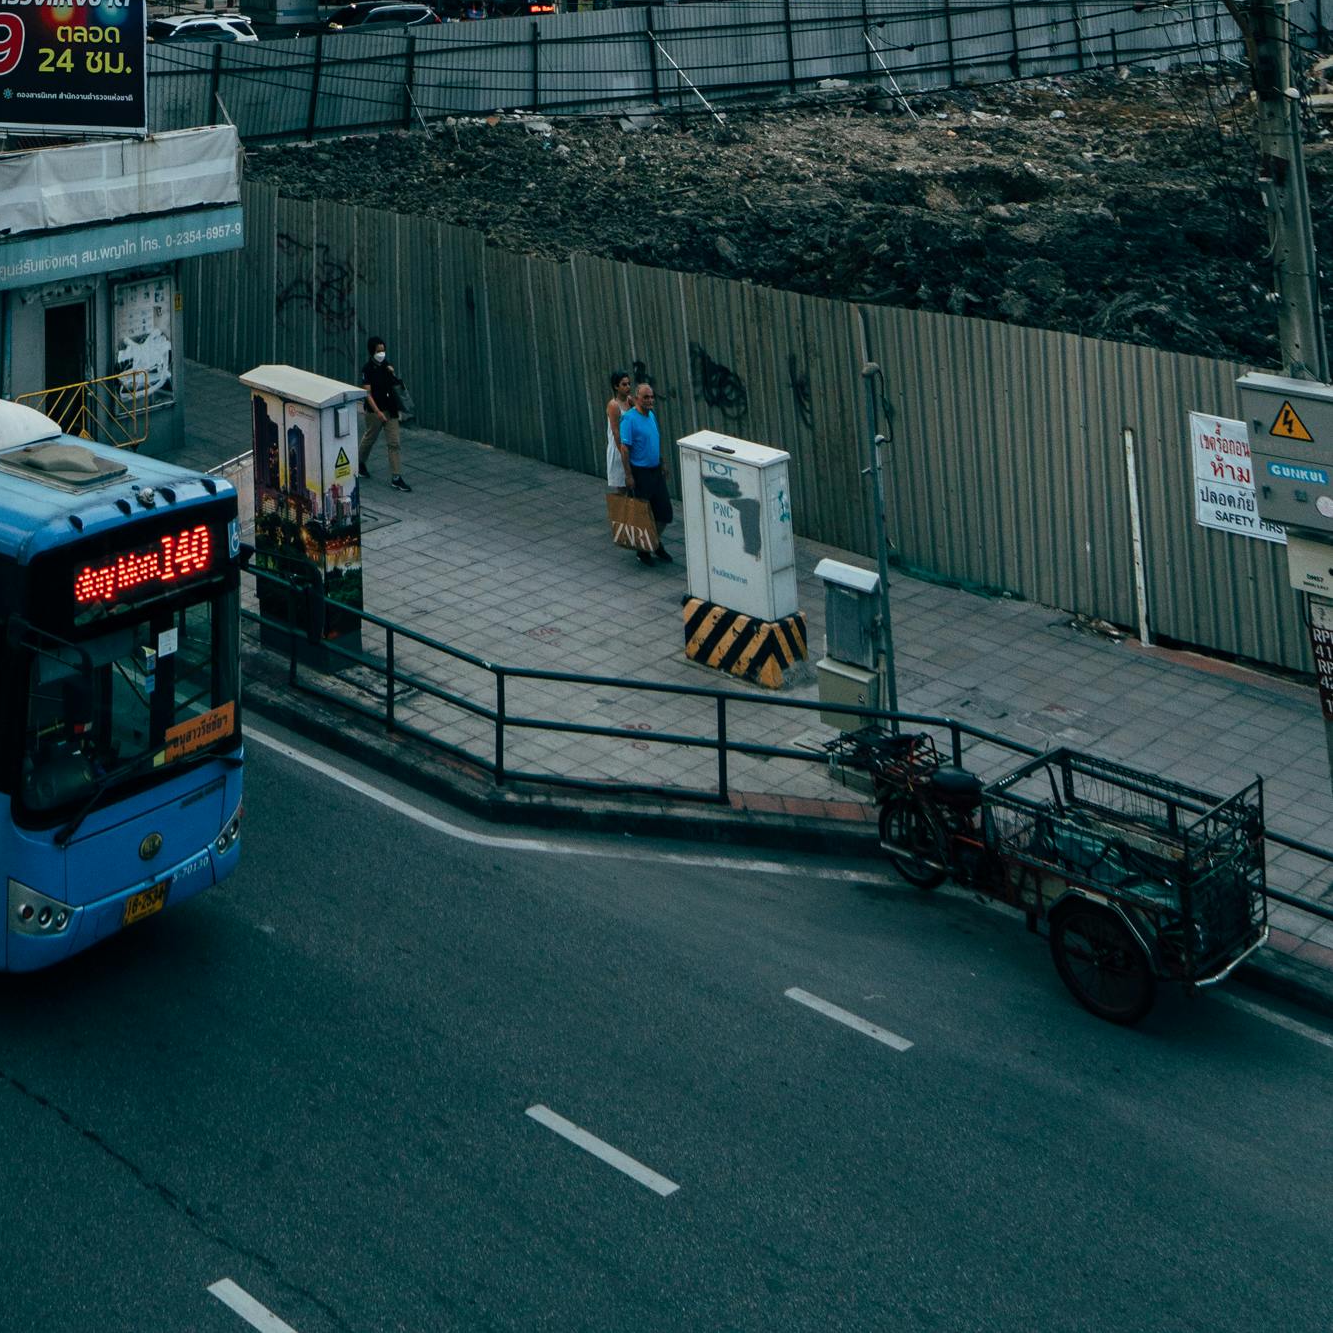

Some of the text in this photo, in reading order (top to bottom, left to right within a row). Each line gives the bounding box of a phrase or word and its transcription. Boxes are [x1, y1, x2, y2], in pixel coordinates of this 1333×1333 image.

[56, 25, 120, 43] ตลอด
[38, 48, 132, 74] 24 ชม.
[81, 238, 137, 263] สน.พญาไท
[141, 236, 162, 251] โทร.
[1210, 454, 1250, 484] ห้าม
[1270, 463, 1326, 484] GUNKUL
[714, 520, 734, 538] 114
[1215, 510, 1255, 528] SAFETY
[161, 524, 209, 580] 140
